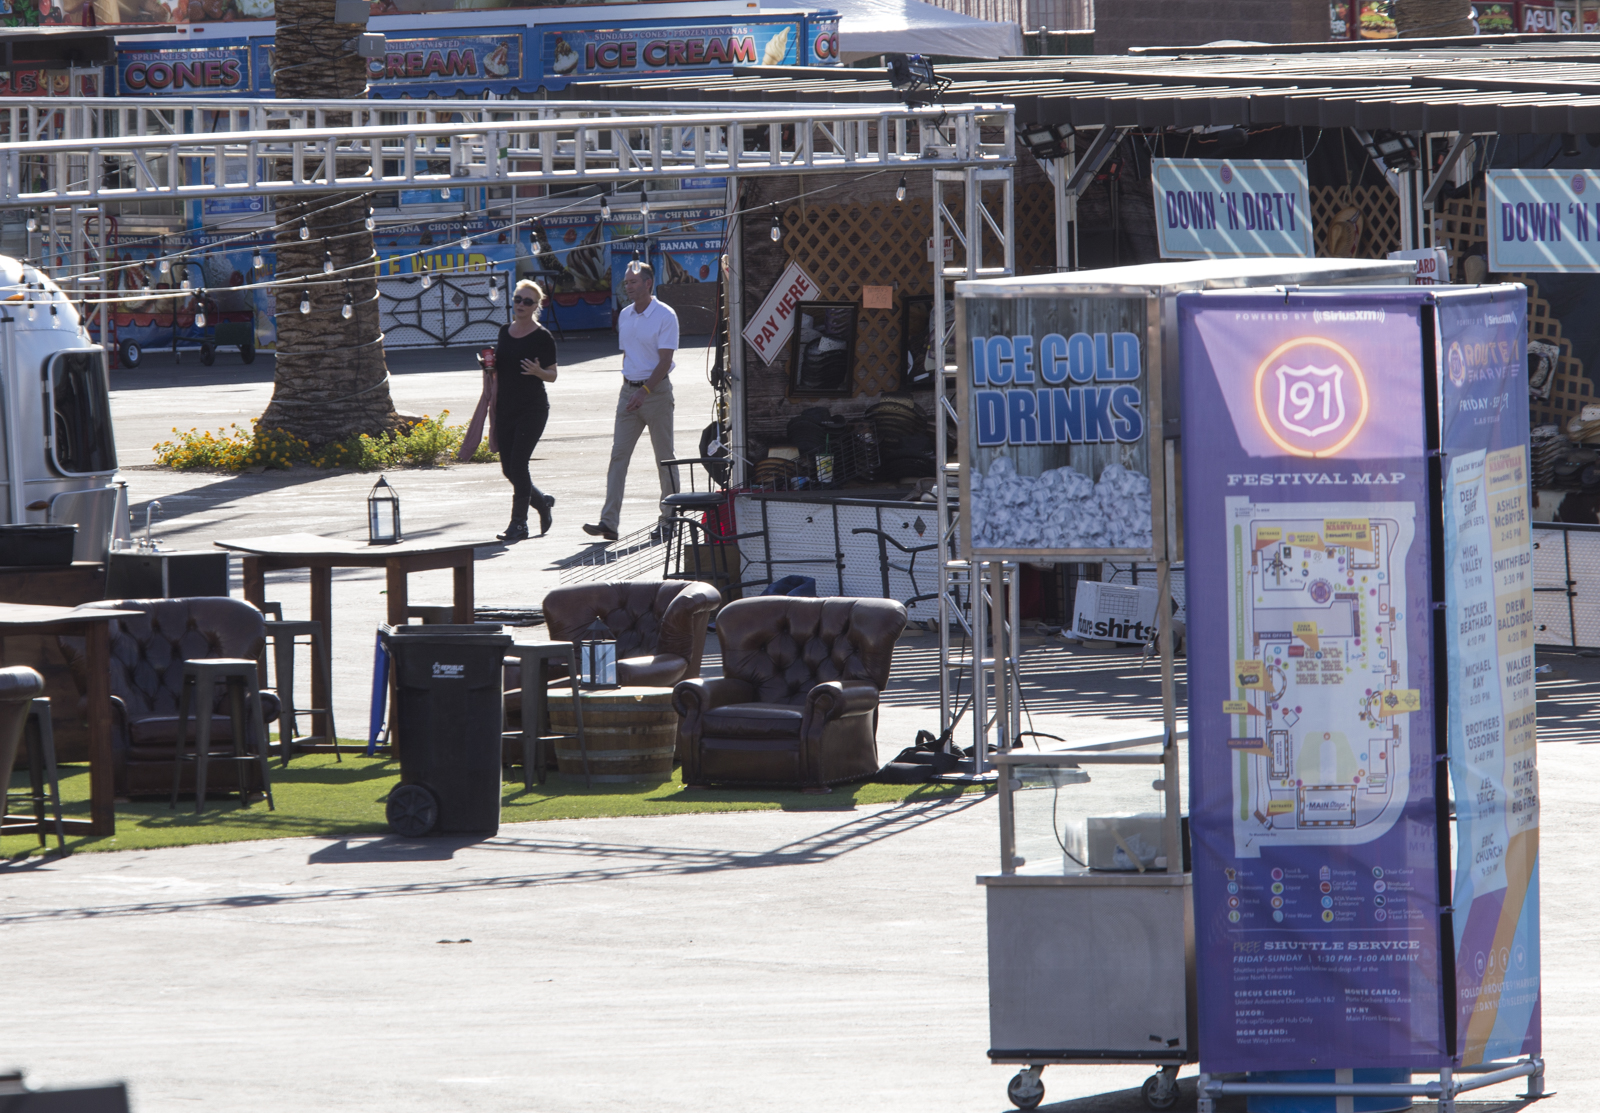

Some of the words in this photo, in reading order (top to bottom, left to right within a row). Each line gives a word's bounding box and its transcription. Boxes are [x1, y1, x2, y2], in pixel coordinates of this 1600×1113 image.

[595, 31, 633, 40] SUNDAES
[640, 29, 668, 39] CONES
[672, 28, 706, 38] FROZEN
[708, 26, 748, 37] BANANAS
[421, 40, 460, 50] TWISTED
[585, 42, 637, 69] ICE
[643, 37, 756, 66] CREAM
[132, 51, 189, 61] SPRINKLES
[190, 51, 207, 60] OR
[209, 50, 230, 59] NUT
[368, 51, 478, 78] CREAM
[126, 60, 241, 89] CONES
[543, 216, 587, 226] TWISTED
[665, 210, 702, 220] CHERRY
[1166, 190, 1216, 229] DOWN
[1242, 191, 1296, 231] DIRTY
[1501, 202, 1561, 242] DOWN
[660, 242, 699, 251] BANANA
[753, 314, 780, 352] PAY
[775, 275, 810, 320] HERE
[1235, 313, 1288, 321] POWERED
[1293, 313, 1307, 321] BY
[972, 335, 1035, 385] ICE
[1040, 332, 1141, 383] COLD
[1464, 341, 1510, 367] ROUTE
[1289, 380, 1332, 421] 91
[1459, 397, 1489, 412] FRIDAY
[976, 384, 1144, 445] DRINKS
[1227, 472, 1348, 486] FESTIVAL
[1352, 472, 1406, 485] MAP
[1497, 496, 1522, 513] ASHLEY
[1494, 509, 1525, 528] McBRYDE
[1501, 530, 1513, 542] 2:45
[1513, 527, 1522, 538] PM
[1462, 544, 1479, 560] HIGH
[1460, 557, 1483, 574] VALLEY
[1494, 552, 1531, 573] SMITHFIELD
[1475, 575, 1483, 586] PM
[1503, 575, 1516, 586] 3:30
[1516, 571, 1525, 582] PM
[1464, 601, 1488, 619] TUCKER
[1505, 598, 1526, 615] DREW
[1094, 617, 1158, 641] shirts
[1460, 614, 1493, 635] BEATHARD
[1497, 609, 1533, 632] BALDRIDGE
[1467, 635, 1477, 647] 4:10
[1478, 633, 1486, 644] PM
[1507, 631, 1519, 643] 4:20
[1520, 629, 1528, 639] PM
[1465, 659, 1492, 678] MICHAEL
[1505, 654, 1532, 673] WALKER
[1472, 675, 1485, 690] RAY
[1506, 668, 1532, 688] McGUIRE
[1470, 693, 1481, 706] 5:20
[1482, 691, 1491, 702] PM
[1465, 715, 1500, 737] BROTHERS
[1508, 712, 1536, 732] MIDLAND
[1468, 730, 1500, 751] OSBORNE
[1309, 801, 1329, 809] MAIN
[1512, 800, 1523, 814] BIG
[1475, 844, 1503, 864] CHURCH
[1233, 940, 1261, 953] FREE
[1264, 941, 1344, 950] SHUTTLE
[1348, 940, 1420, 950] SERVICE
[1233, 954, 1303, 963] FRIDAY-SUNDAY
[1318, 954, 1336, 962] 1:30
[1380, 953, 1394, 961] AM
[1395, 952, 1420, 962] DAILY
[1264, 989, 1296, 997] CIRCUS:
[1370, 988, 1401, 996] CARLO:
[1257, 1028, 1288, 1036] GRAND:
